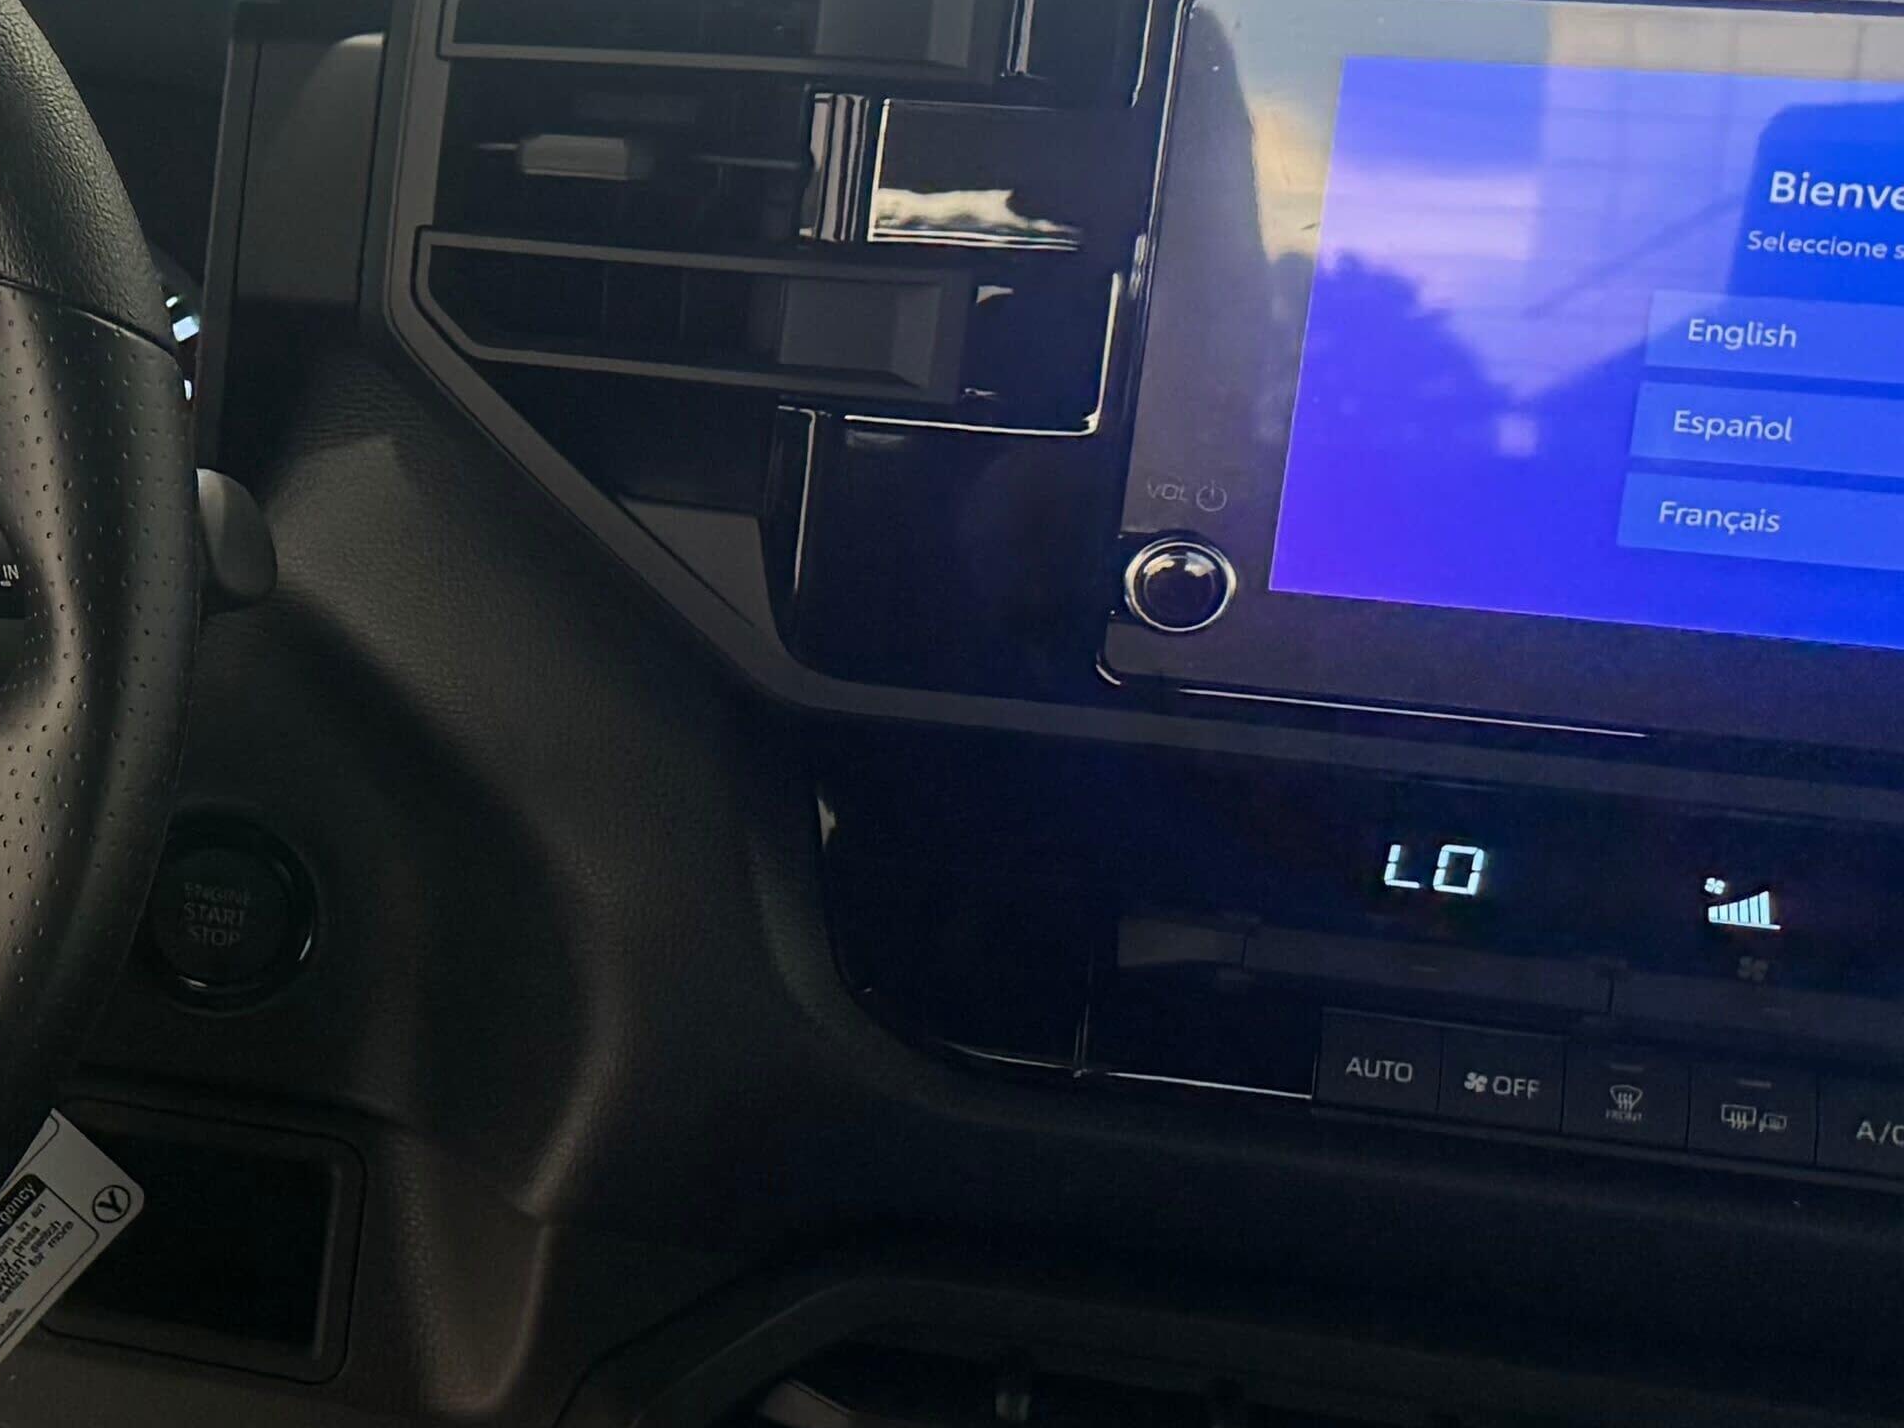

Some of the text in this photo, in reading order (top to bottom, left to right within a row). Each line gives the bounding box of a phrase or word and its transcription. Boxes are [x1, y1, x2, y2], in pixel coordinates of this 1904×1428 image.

[1747, 230, 1888, 259] Seleccione
[1687, 318, 1797, 351] English
[1673, 409, 1793, 442] Español
[1146, 478, 1188, 502] VOL
[1658, 500, 1781, 535] Français
[183, 902, 247, 925] START
[189, 926, 241, 948] STOP
[1345, 1056, 1413, 1083] AUTO
[1492, 1075, 1541, 1099] OFF
[96, 1189, 128, 1221] Y
